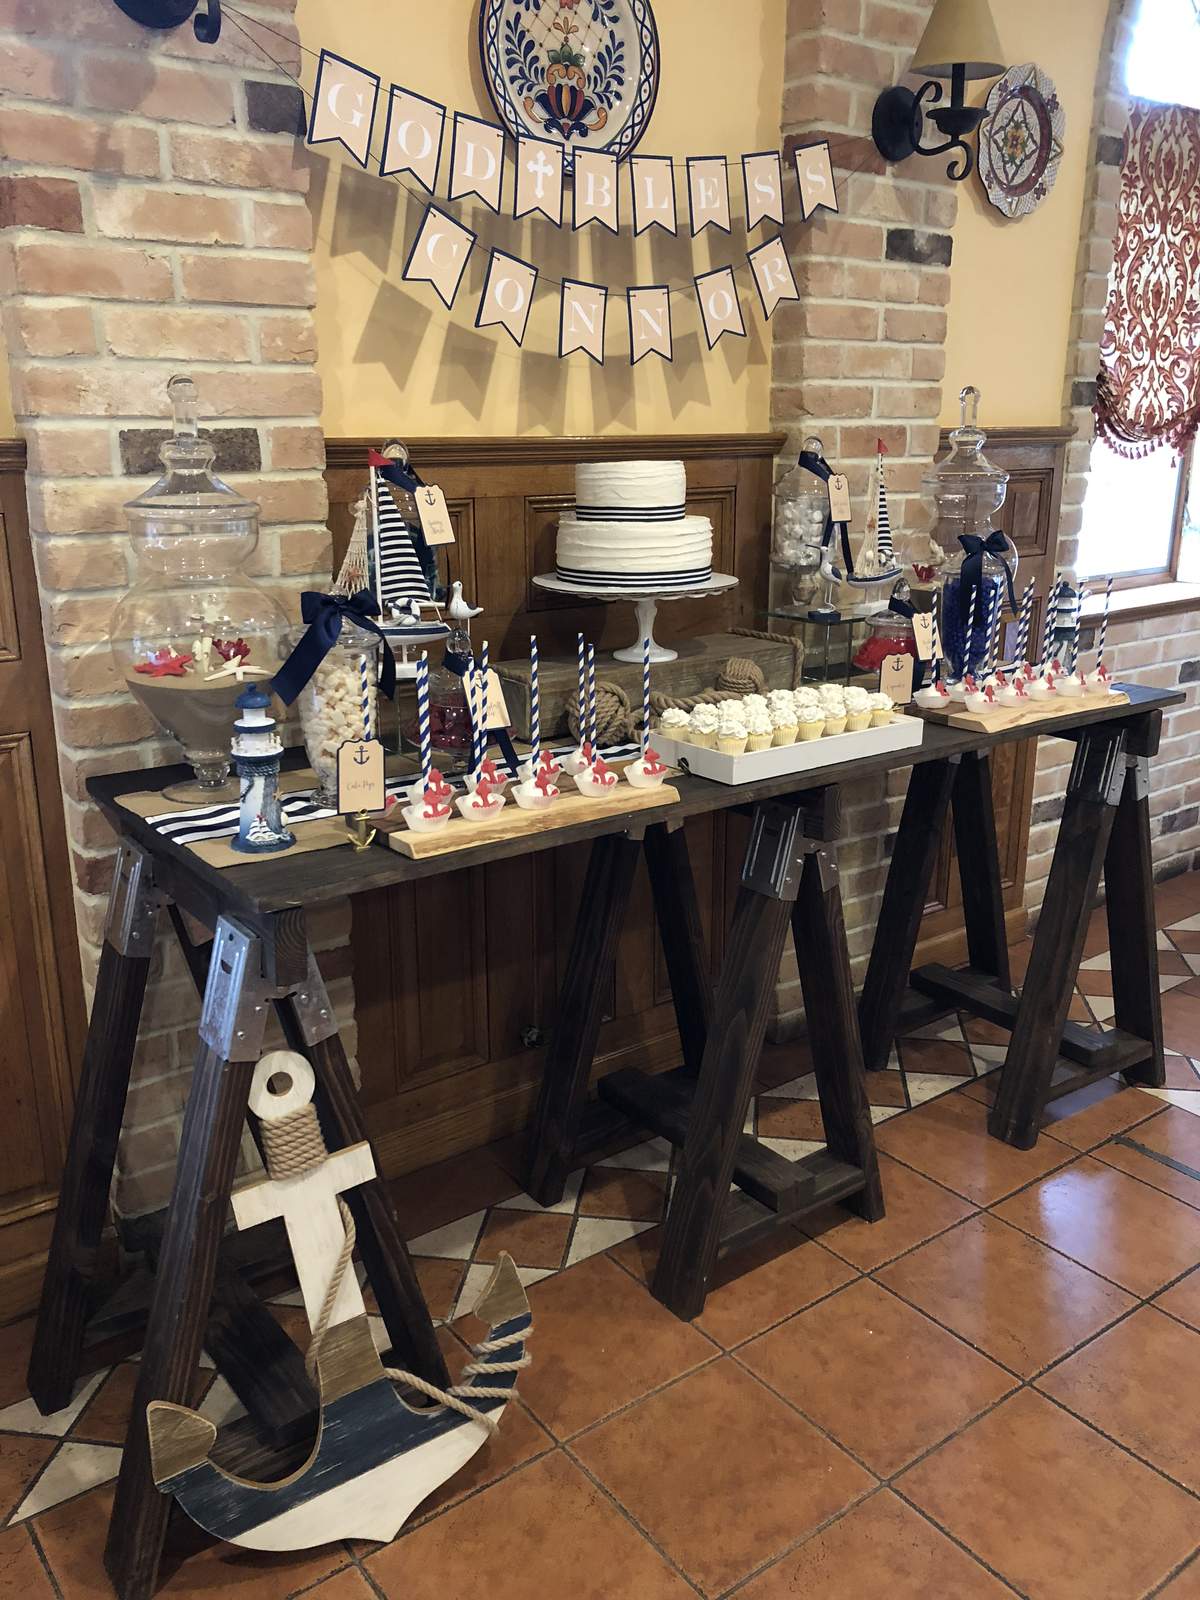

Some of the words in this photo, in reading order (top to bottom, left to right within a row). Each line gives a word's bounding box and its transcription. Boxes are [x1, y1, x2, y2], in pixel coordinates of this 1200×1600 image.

[327, 83, 496, 180] GOD
[584, 164, 827, 208] BLESS
[426, 233, 788, 340] CONNOR
